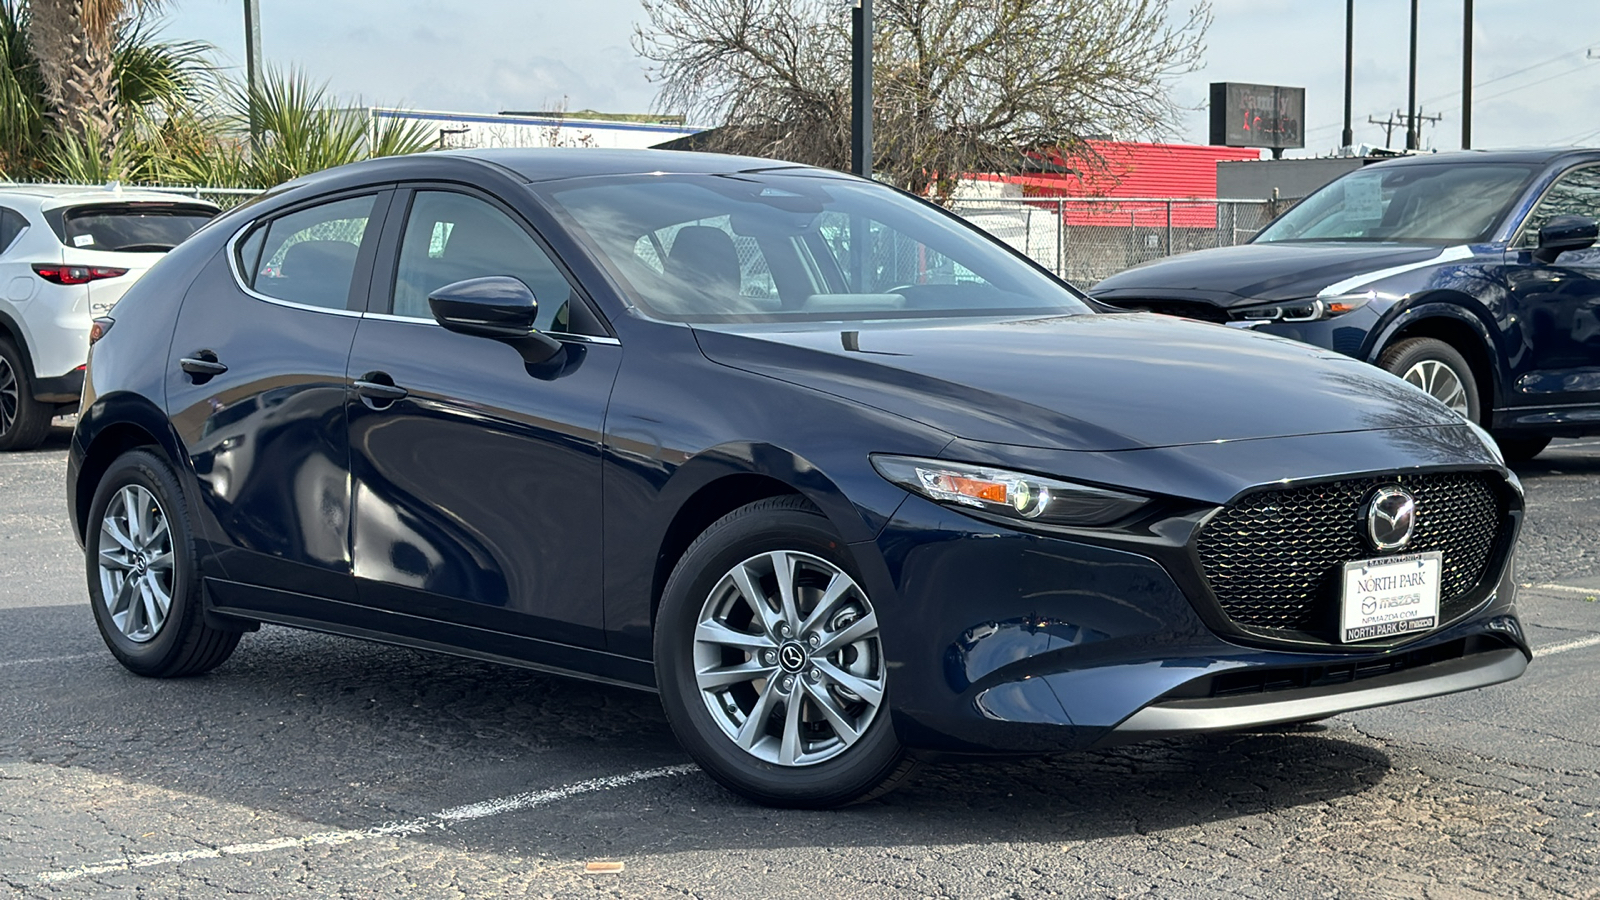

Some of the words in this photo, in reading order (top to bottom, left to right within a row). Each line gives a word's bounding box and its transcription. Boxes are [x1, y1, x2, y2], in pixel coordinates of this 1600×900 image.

[1357, 575, 1397, 594] NORTH
[1399, 571, 1426, 588] PARK
[1379, 593, 1421, 609] mazda
[1348, 628, 1375, 640] NORTH
[1377, 622, 1398, 635] PARK
